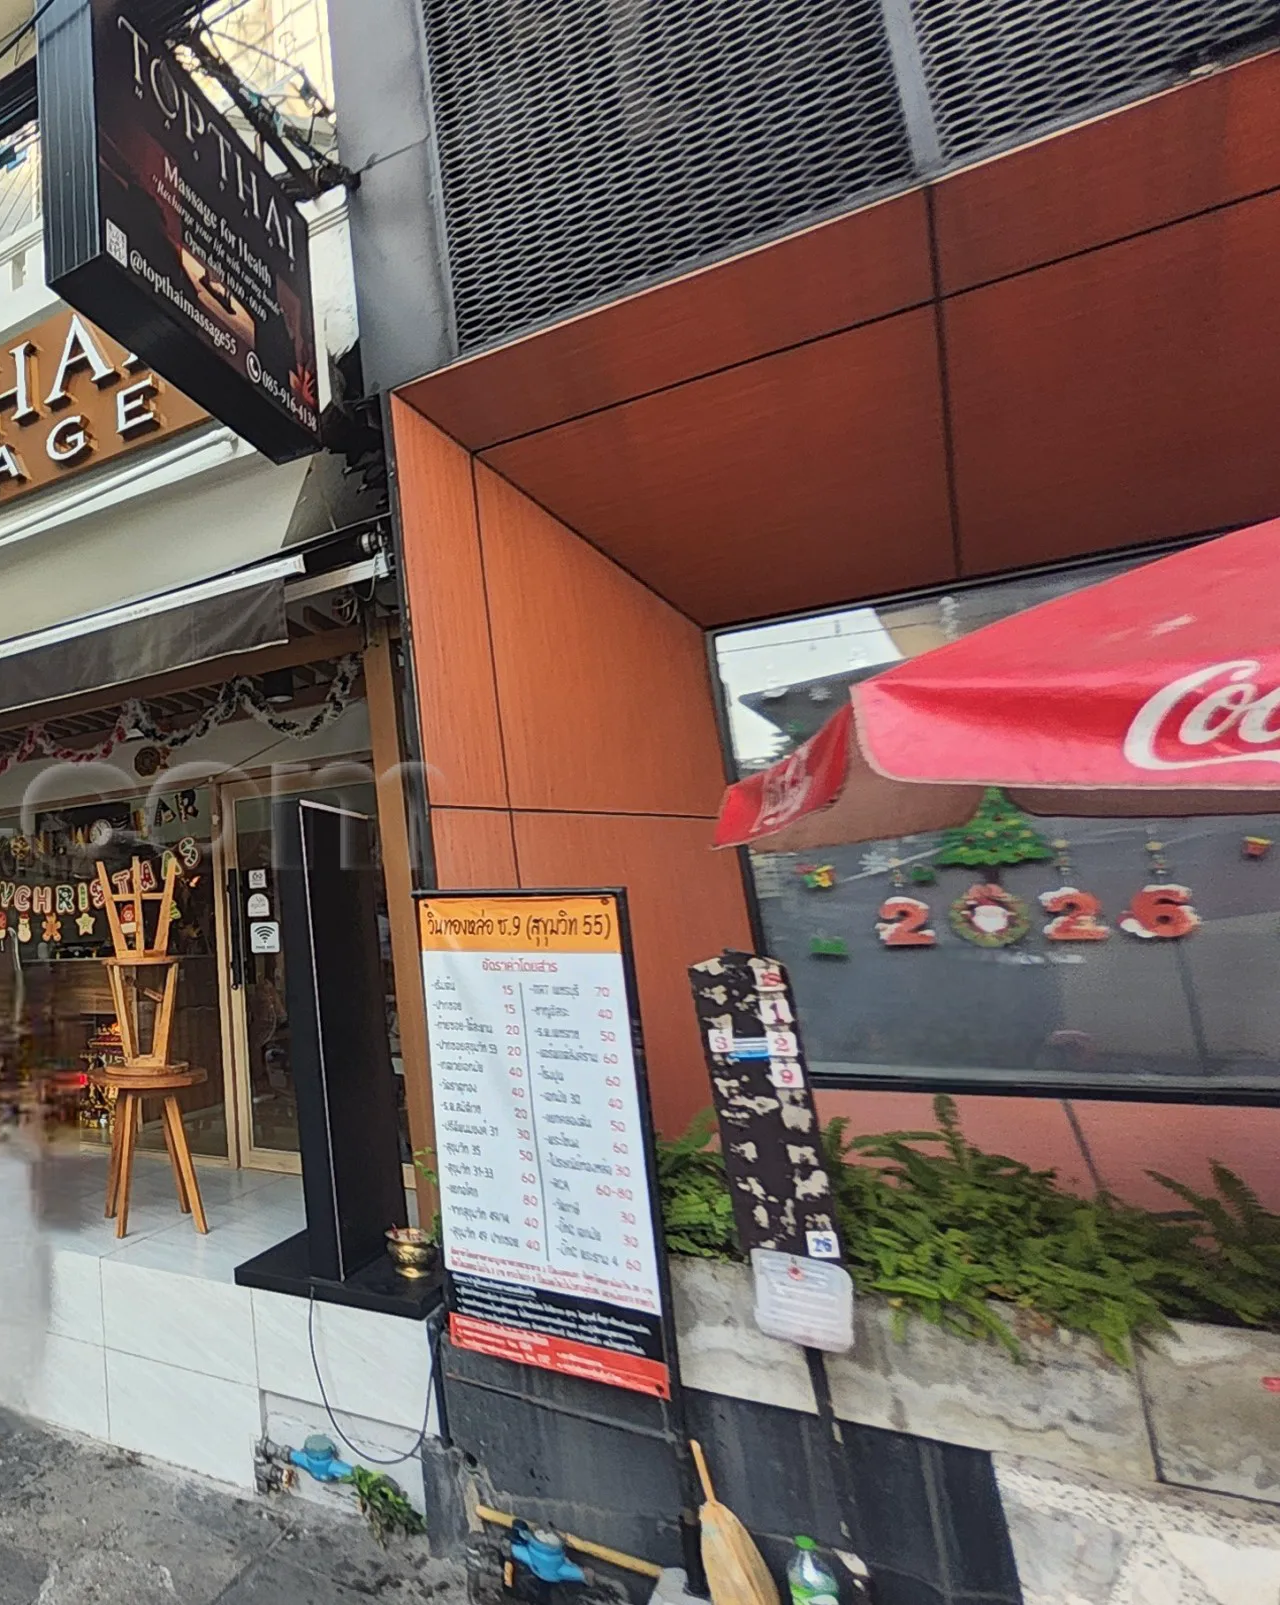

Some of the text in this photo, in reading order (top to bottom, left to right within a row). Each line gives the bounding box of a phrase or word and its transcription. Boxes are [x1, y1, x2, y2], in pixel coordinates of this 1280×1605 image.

[164, 157, 272, 288] Massage for Health
[185, 231, 206, 261] Open
[207, 254, 225, 282] daily
[130, 250, 237, 355] @topthaimassage55
[427, 909, 494, 937] วินทองหล่อ
[498, 916, 521, 937] ซ.9
[582, 913, 612, 939] 55)
[482, 956, 558, 974] อัตราค่าโดยสาร
[502, 985, 514, 995] 15
[594, 986, 610, 998] 70
[504, 1004, 516, 1014] 15
[598, 1009, 613, 1020] 40
[506, 1025, 520, 1035] 20
[600, 1030, 616, 1042] 50
[507, 1046, 521, 1057] 20
[603, 1053, 619, 1065] 60
[509, 1067, 523, 1077] 40
[606, 1075, 621, 1087] 60
[512, 1087, 524, 1098] 40
[608, 1098, 623, 1110] 40
[515, 1107, 528, 1119] 20
[610, 1120, 626, 1133] 50
[517, 1128, 531, 1140] 30
[613, 1142, 629, 1155] 60
[520, 1149, 533, 1162] 50
[615, 1164, 632, 1178] 30
[521, 1172, 536, 1185] 60
[524, 1217, 539, 1229] 40
[620, 1211, 637, 1225] 30
[526, 1239, 540, 1251] 40
[623, 1234, 639, 1249] 30
[626, 1258, 641, 1272] 60
